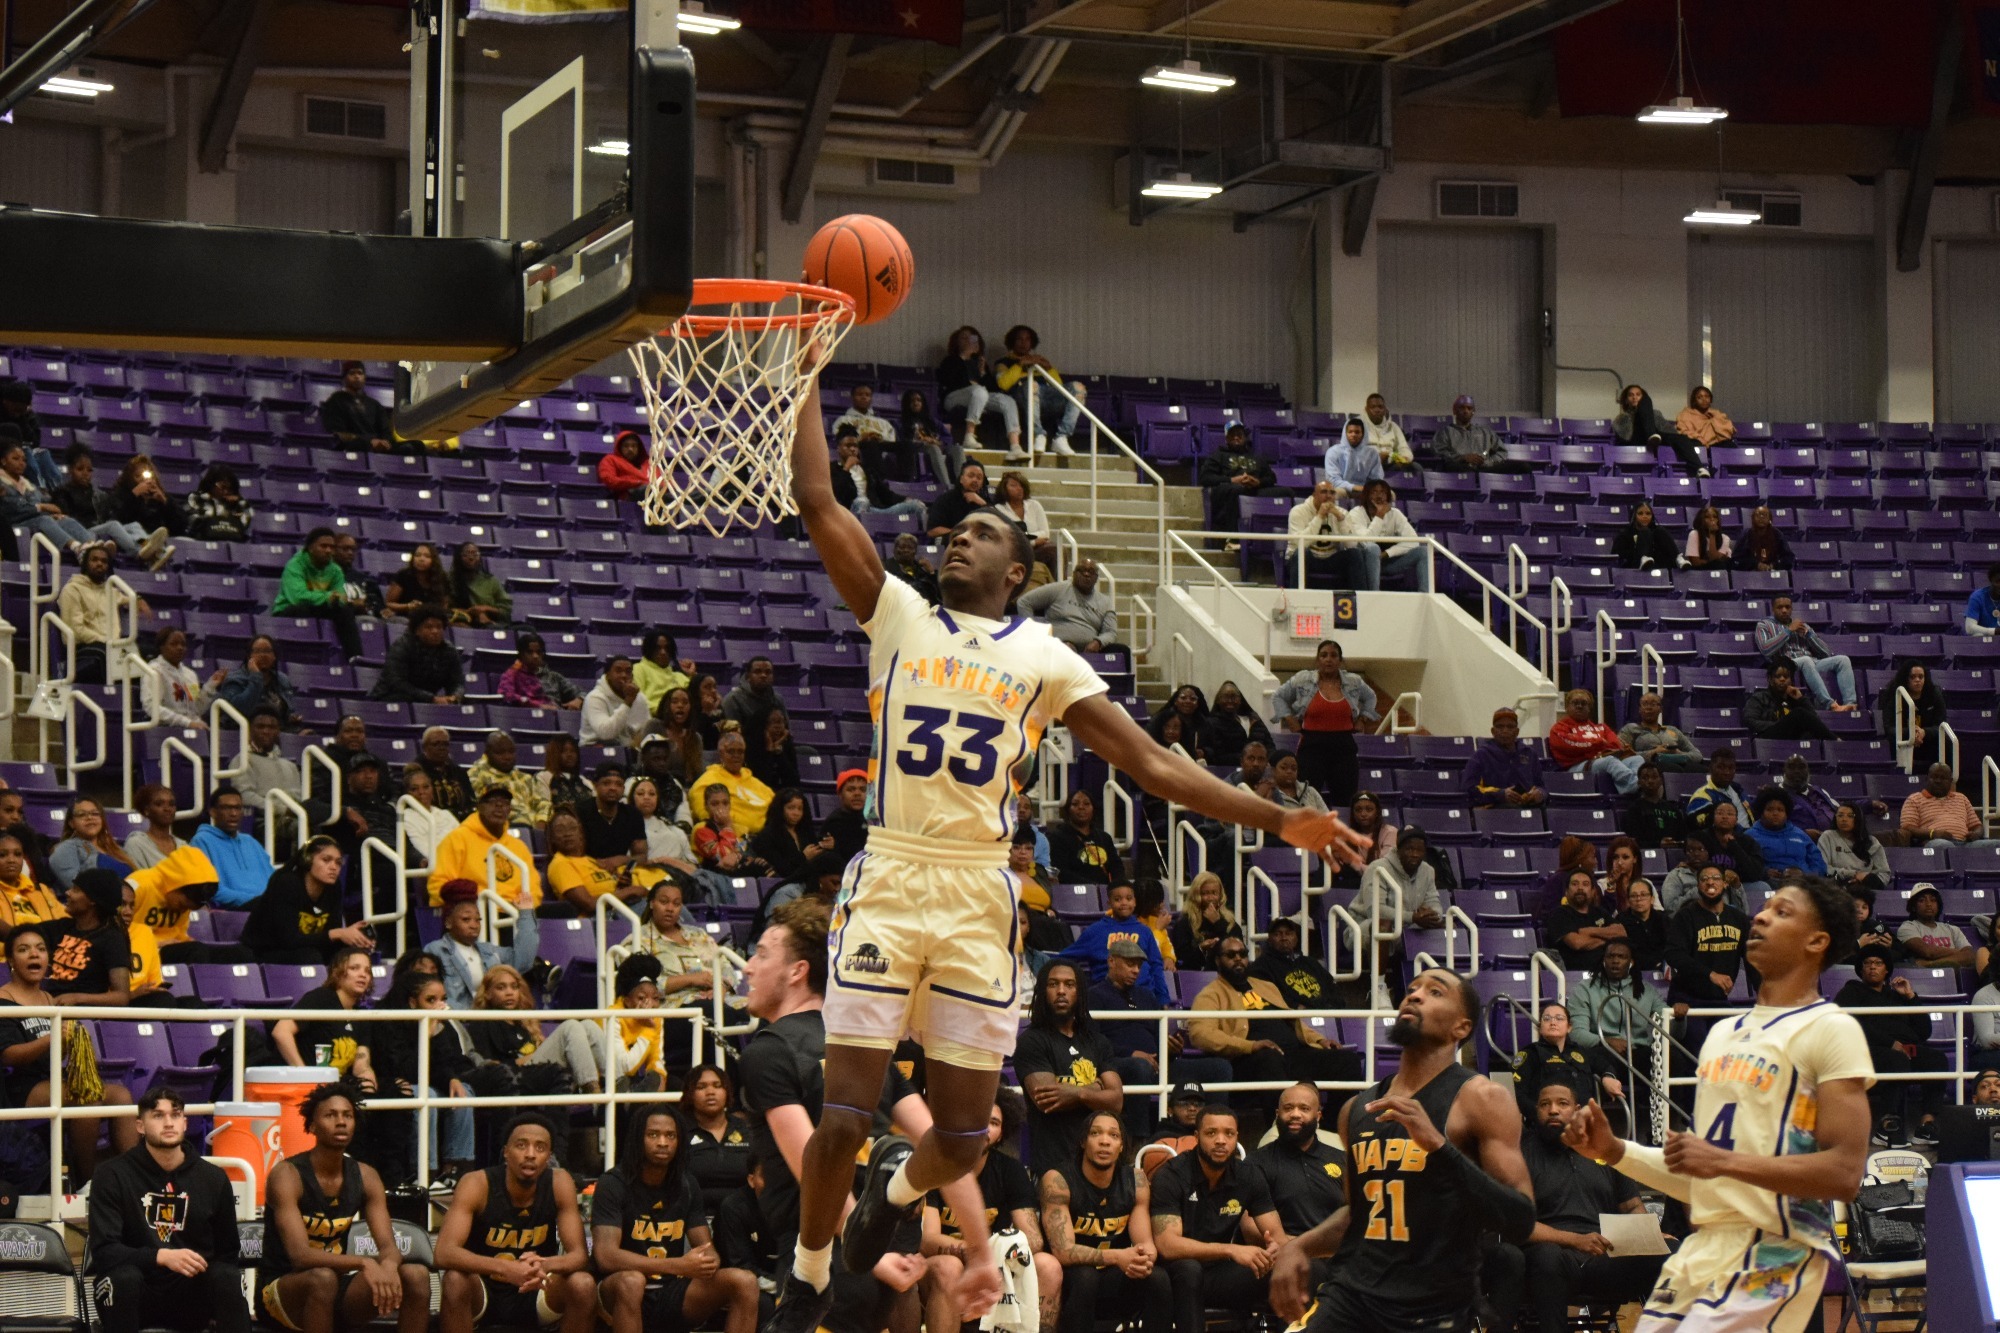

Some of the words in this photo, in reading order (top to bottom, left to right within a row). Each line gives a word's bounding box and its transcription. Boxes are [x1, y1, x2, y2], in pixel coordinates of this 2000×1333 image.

[1295, 614, 1322, 636] EXIT
[1337, 598, 1353, 619] 3
[895, 704, 1006, 787] 33
[844, 953, 891, 974] PVAMU
[1704, 1102, 1737, 1152] 4
[1363, 1179, 1410, 1242] 21
